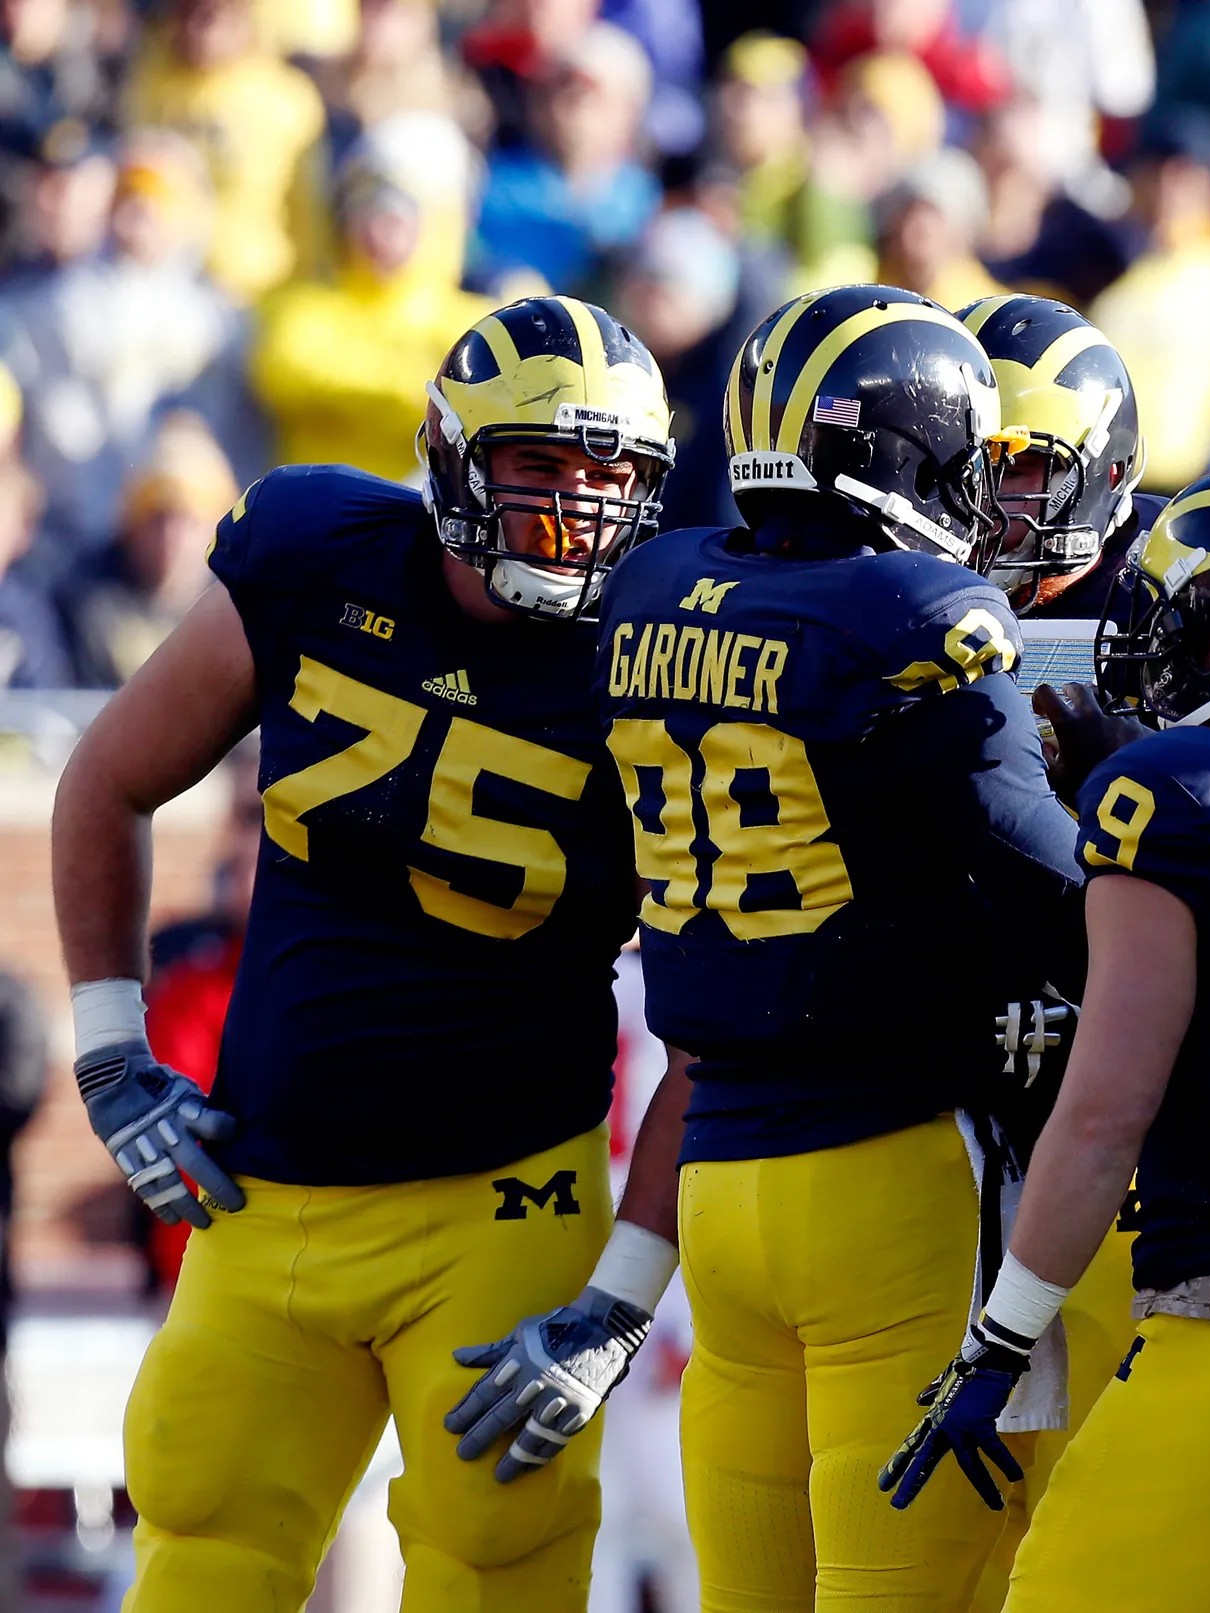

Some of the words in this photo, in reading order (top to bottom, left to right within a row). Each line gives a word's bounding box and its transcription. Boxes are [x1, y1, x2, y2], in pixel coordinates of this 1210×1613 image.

[575, 409, 618, 425] MICHIGAN
[733, 458, 794, 480] schutt
[914, 516, 955, 547] ADAMS
[679, 577, 740, 613] M
[608, 622, 788, 714] GARDNER
[421, 680, 478, 706] adidas
[262, 654, 592, 940] 75
[605, 718, 854, 942] 98
[1085, 776, 1155, 871] 9
[492, 1170, 580, 1220] M
